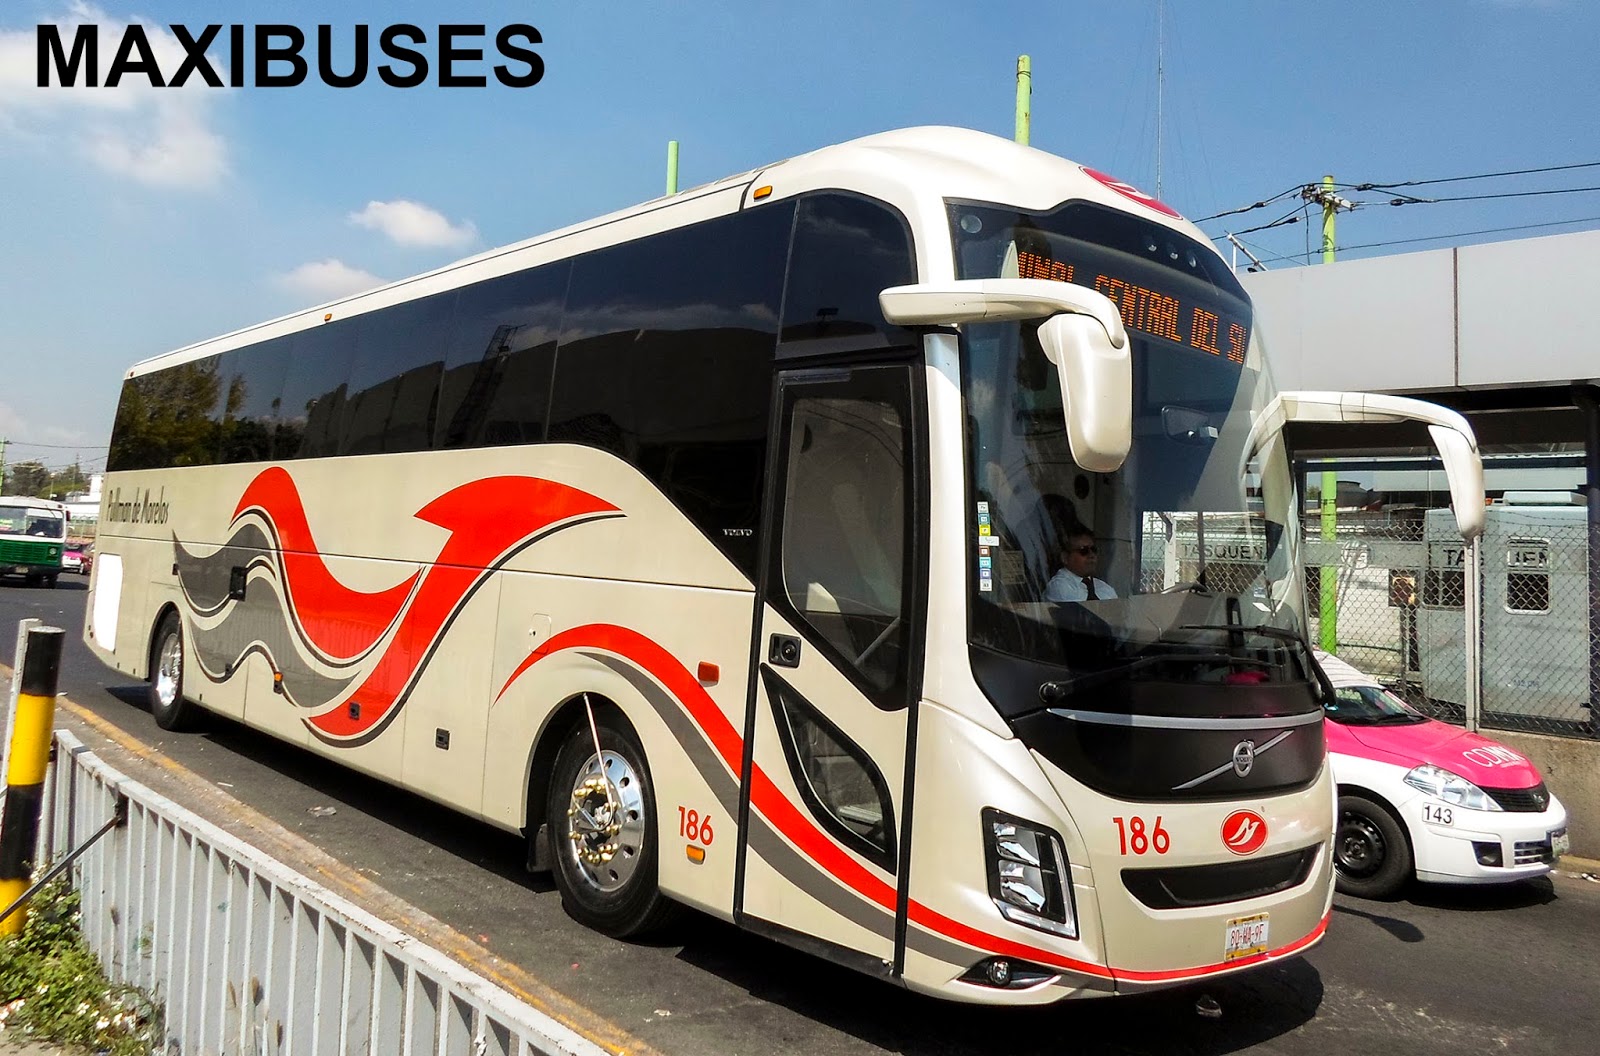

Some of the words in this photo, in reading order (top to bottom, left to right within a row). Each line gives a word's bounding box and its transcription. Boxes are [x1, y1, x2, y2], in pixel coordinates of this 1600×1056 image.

[1190, 307, 1220, 356] DEL
[140, 486, 169, 524] Morelos
[1462, 745, 1526, 768] CDMX
[678, 805, 714, 846] 186
[1424, 804, 1453, 824] 143
[1112, 815, 1171, 856] 186
